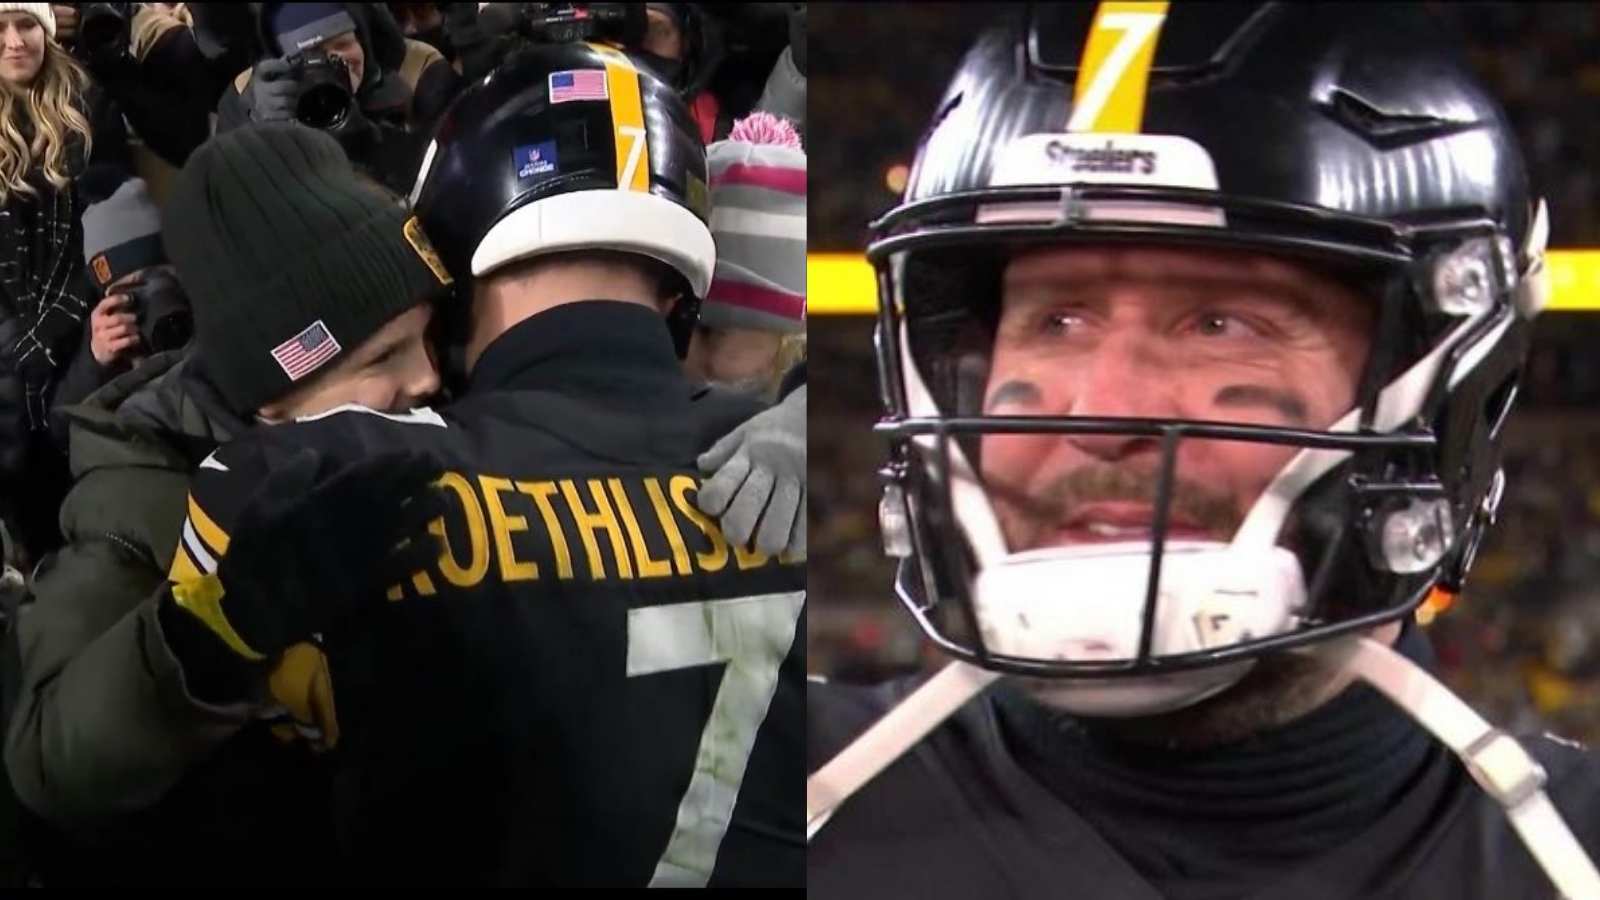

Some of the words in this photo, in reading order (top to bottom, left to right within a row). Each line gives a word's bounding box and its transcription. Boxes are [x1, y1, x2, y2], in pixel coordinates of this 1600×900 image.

[1066, 12, 1168, 132] 7
[618, 126, 647, 191] 7
[387, 471, 807, 600] OETHLIS
[626, 590, 807, 888] 7
